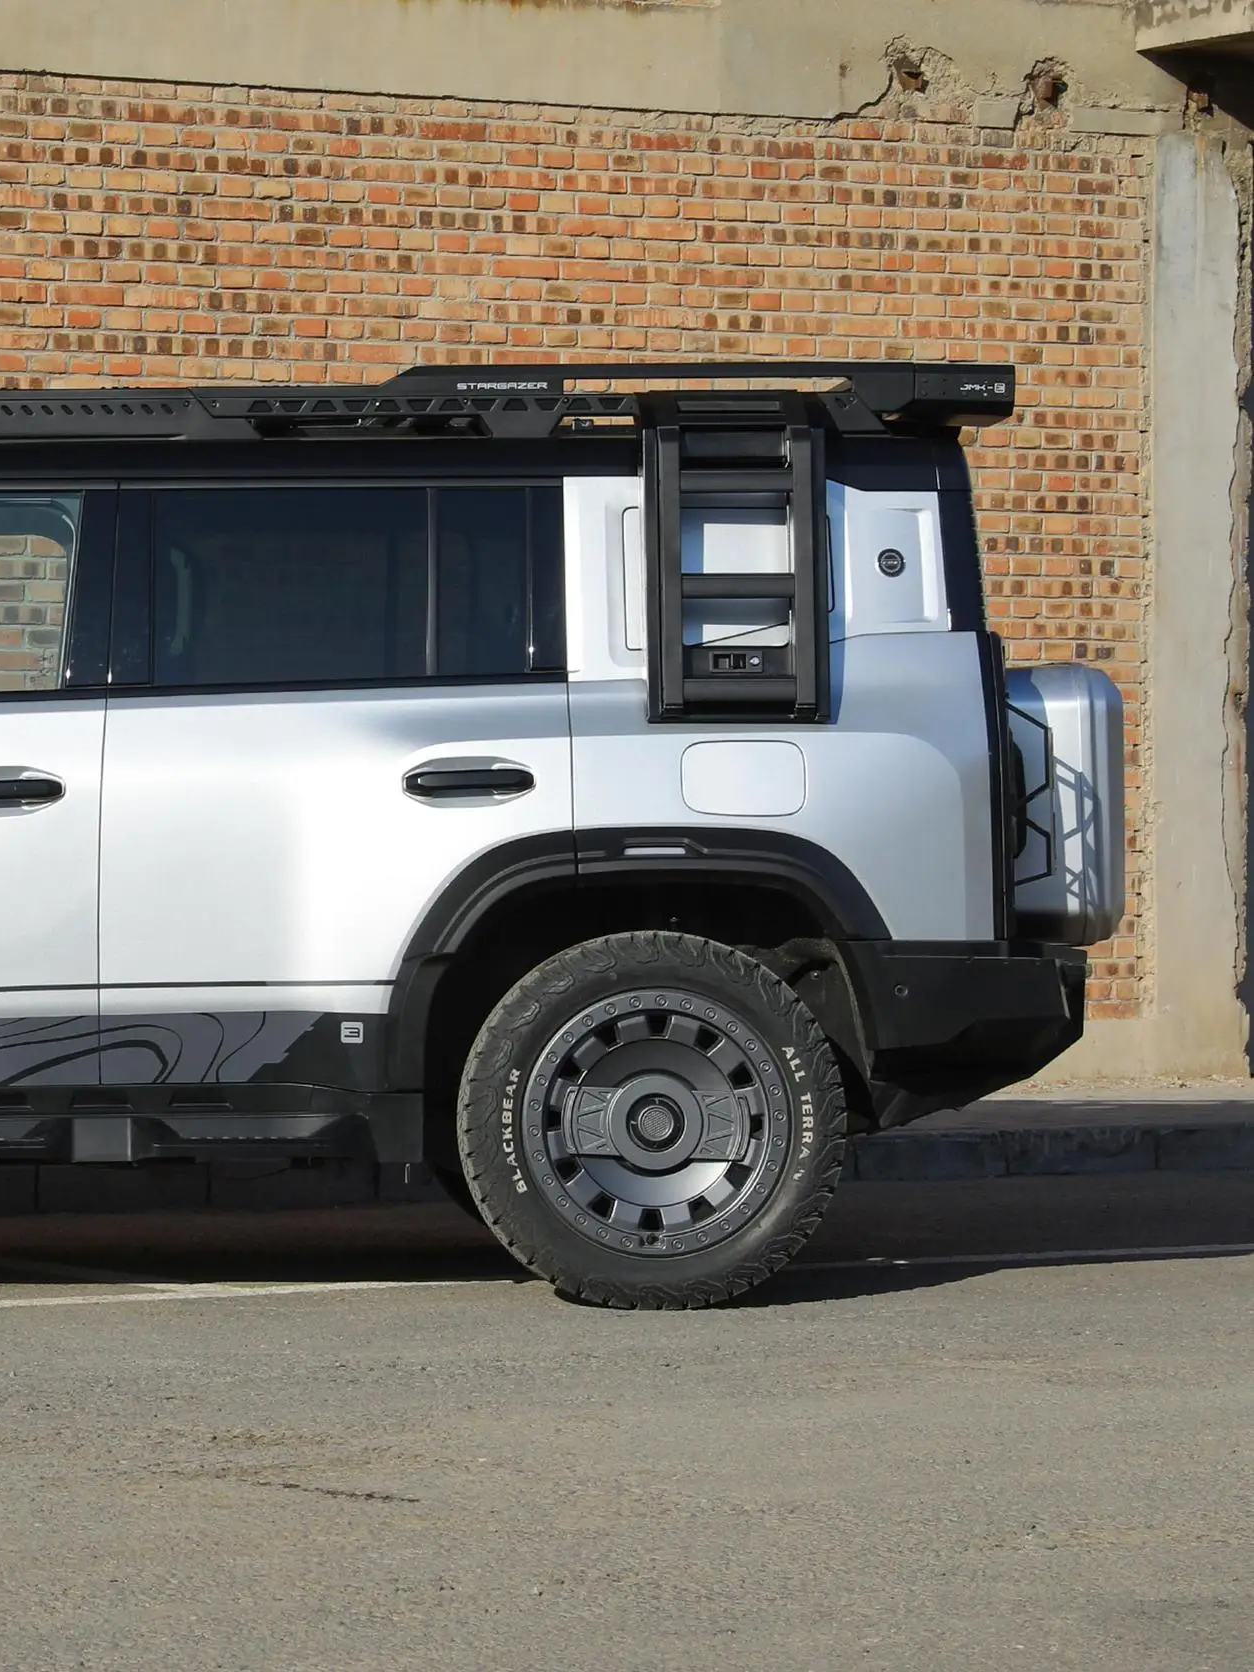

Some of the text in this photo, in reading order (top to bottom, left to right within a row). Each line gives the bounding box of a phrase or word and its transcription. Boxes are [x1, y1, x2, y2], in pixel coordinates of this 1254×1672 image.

[457, 382, 548, 390] STARGAZER
[782, 1046, 806, 1082] ALL
[501, 1068, 528, 1194] BLACKBEAR
